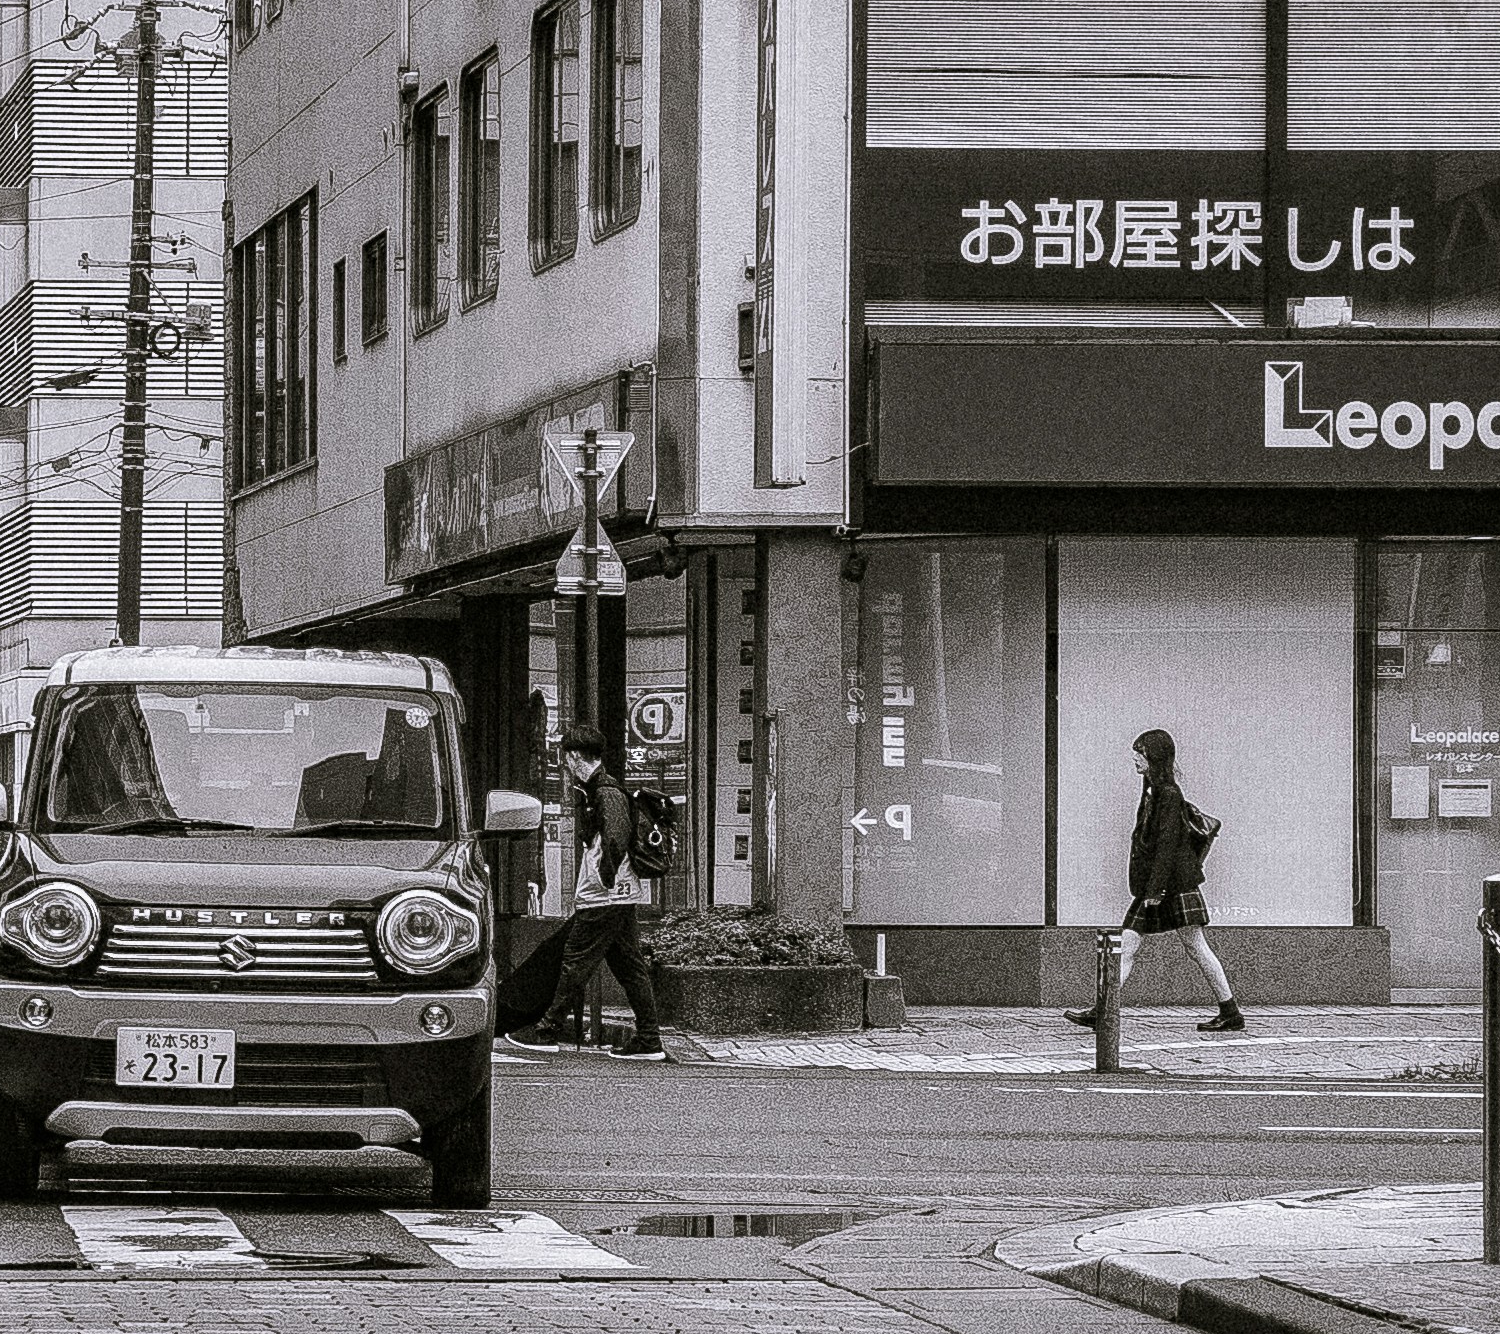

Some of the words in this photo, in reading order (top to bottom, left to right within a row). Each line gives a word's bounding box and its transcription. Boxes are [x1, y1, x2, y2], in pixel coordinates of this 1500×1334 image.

[960, 197, 1415, 271] お部屋探しは
[1455, 763, 1475, 774] 松本
[617, 882, 632, 895] 23
[132, 907, 347, 928] HUSTLER
[123, 1058, 137, 1075] そ
[141, 1052, 229, 1084] 23-17
